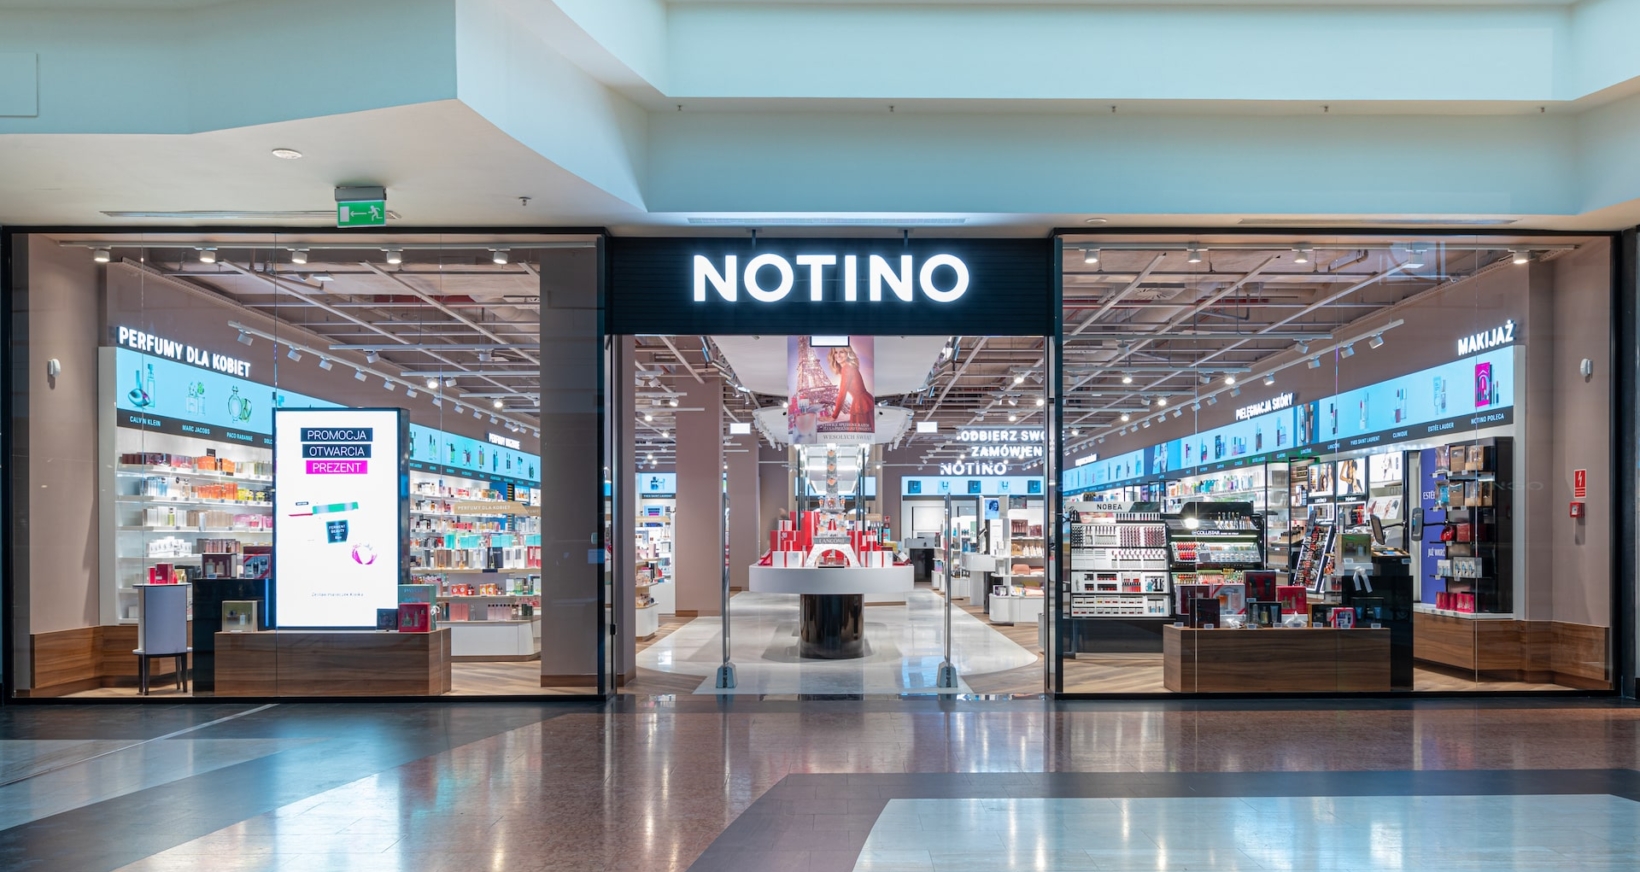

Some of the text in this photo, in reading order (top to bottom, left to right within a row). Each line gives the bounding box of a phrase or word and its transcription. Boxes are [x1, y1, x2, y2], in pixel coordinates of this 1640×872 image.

[693, 253, 970, 303] NOTINO
[1458, 319, 1515, 355] MAKIJAŻ
[118, 326, 251, 377] PERFUMY DLA KOBIET
[1235, 392, 1293, 420] PIELĘGNACJA SKÓRY
[129, 415, 161, 427] CALVIN KLEIN
[1471, 412, 1505, 425] NOTINO POLECA
[182, 424, 210, 435] MARC JACOBS
[1428, 421, 1454, 432] ESTÉE LAUDER
[307, 430, 367, 441] PROMOCJA
[961, 430, 1018, 442] ODBIERZ
[309, 446, 365, 457] OTWARCIA
[312, 463, 362, 473] PREZENT
[940, 461, 1007, 476] NOTINO
[1096, 503, 1123, 511] NOBEA
